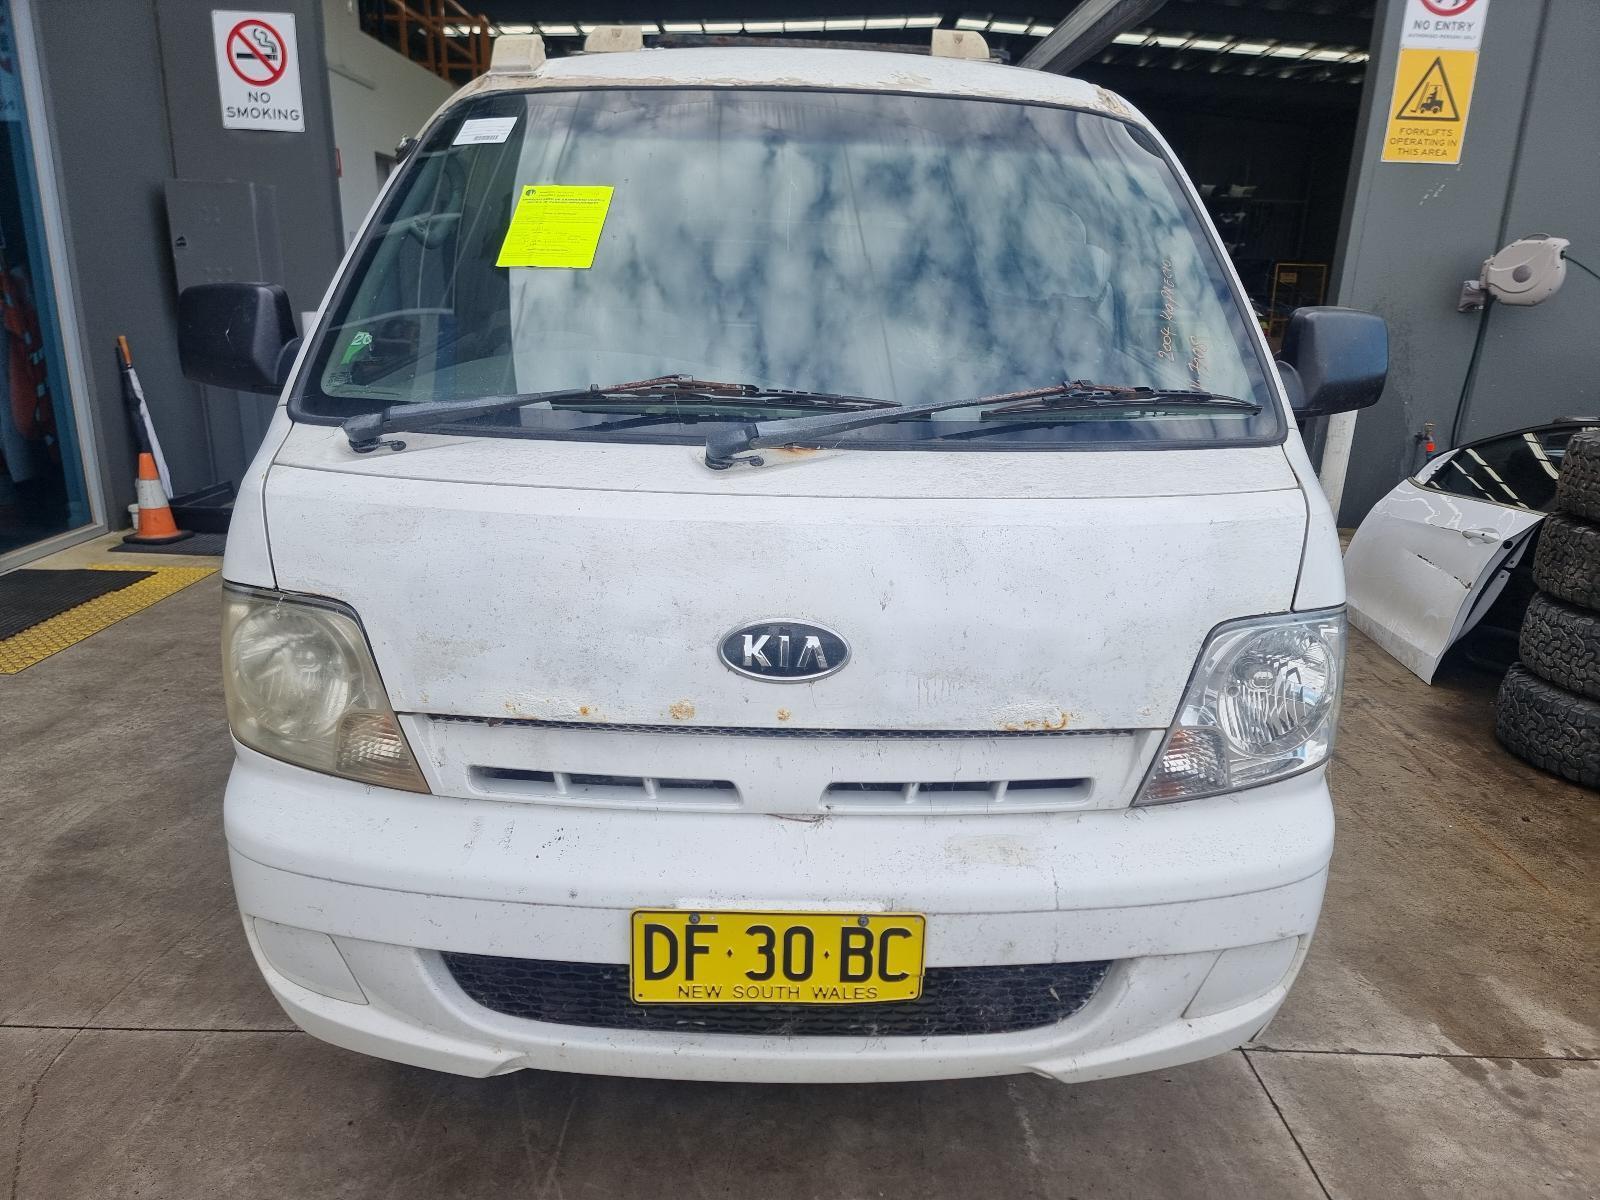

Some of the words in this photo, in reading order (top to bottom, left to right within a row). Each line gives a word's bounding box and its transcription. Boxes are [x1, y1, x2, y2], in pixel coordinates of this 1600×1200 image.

[1413, 20, 1431, 30] NO
[1435, 20, 1476, 32] ENTRY
[248, 91, 271, 103] NO
[226, 106, 300, 121] SMOKING
[1399, 127, 1454, 137] FORKLIFTS
[1390, 137, 1446, 147] OPERATING
[1447, 139, 1458, 147] IN
[1398, 147, 1420, 156] THIS
[1421, 148, 1448, 157] AREA
[741, 634, 829, 669] KIA
[644, 923, 719, 981] DF
[744, 924, 814, 982] 30
[839, 926, 913, 984] BC
[677, 985, 723, 999] NEW
[732, 986, 800, 1000] SOUTH
[812, 986, 878, 1000] WALES
